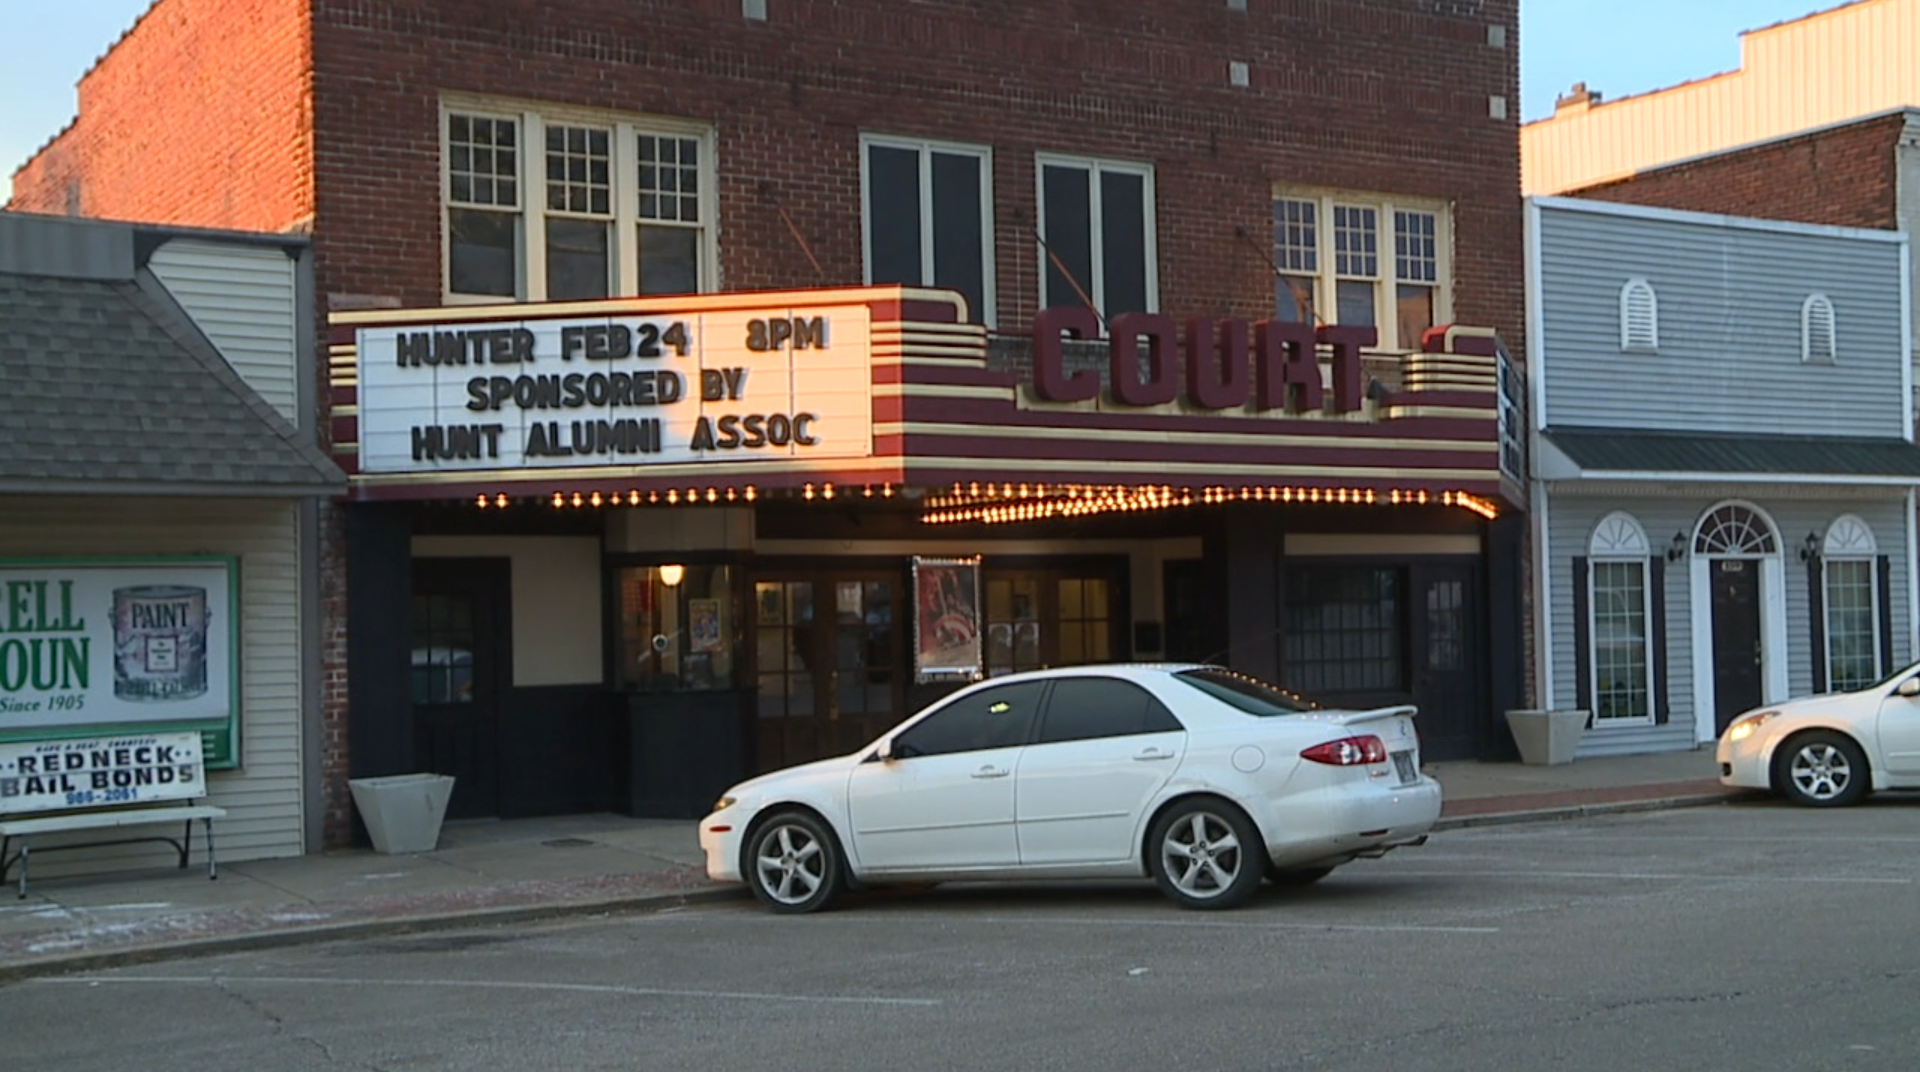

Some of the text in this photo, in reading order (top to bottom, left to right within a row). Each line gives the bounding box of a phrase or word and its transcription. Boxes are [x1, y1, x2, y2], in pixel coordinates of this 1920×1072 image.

[396, 328, 535, 367] HUNTER
[745, 317, 824, 351] 8PM
[1033, 306, 1377, 412] COURT
[466, 367, 744, 411] SPONSORED BY
[411, 412, 815, 461] HUNT ALUMNI ASSOC
[0, 580, 84, 632] ELL
[131, 602, 190, 629] PAINT
[0, 637, 90, 692] OUN
[0, 695, 85, 713] Since 1905
[1, 765, 193, 798] BAIL BONDS
[17, 745, 176, 775] REDNECK
